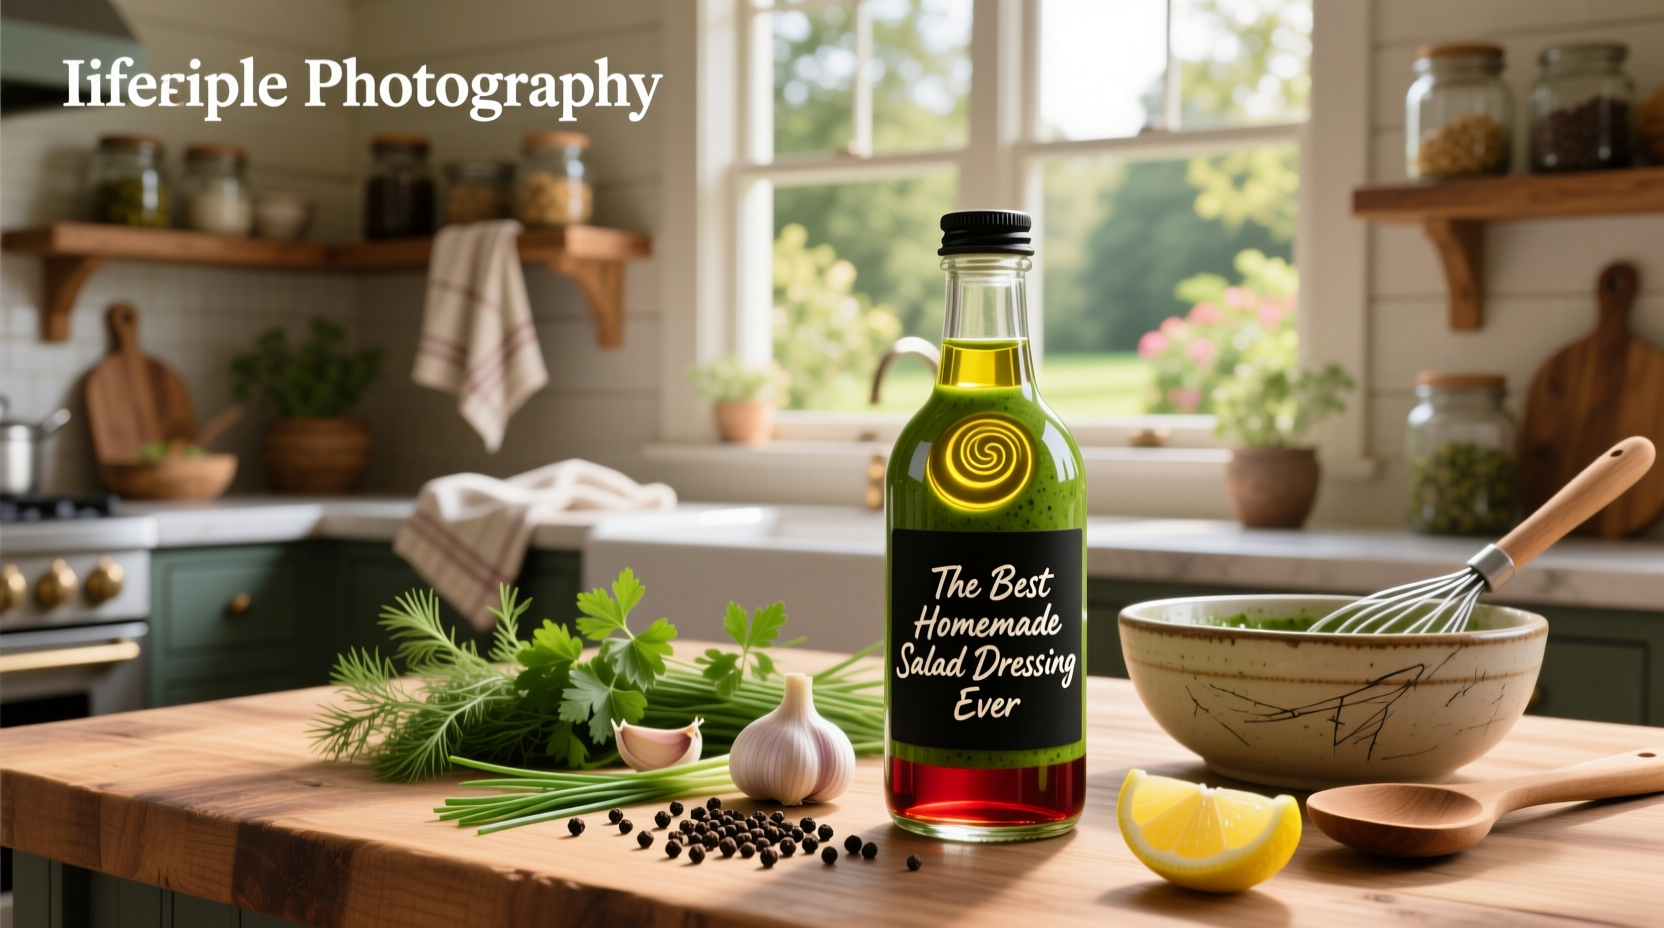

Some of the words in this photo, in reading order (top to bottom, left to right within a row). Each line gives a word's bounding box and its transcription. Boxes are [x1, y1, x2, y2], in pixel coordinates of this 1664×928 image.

[931, 564, 982, 600] The
[989, 564, 1055, 601] Best
[913, 602, 1063, 641] Homemade
[896, 642, 968, 679] Salad
[972, 644, 1077, 689] Dressing
[953, 686, 1022, 721] Ever
